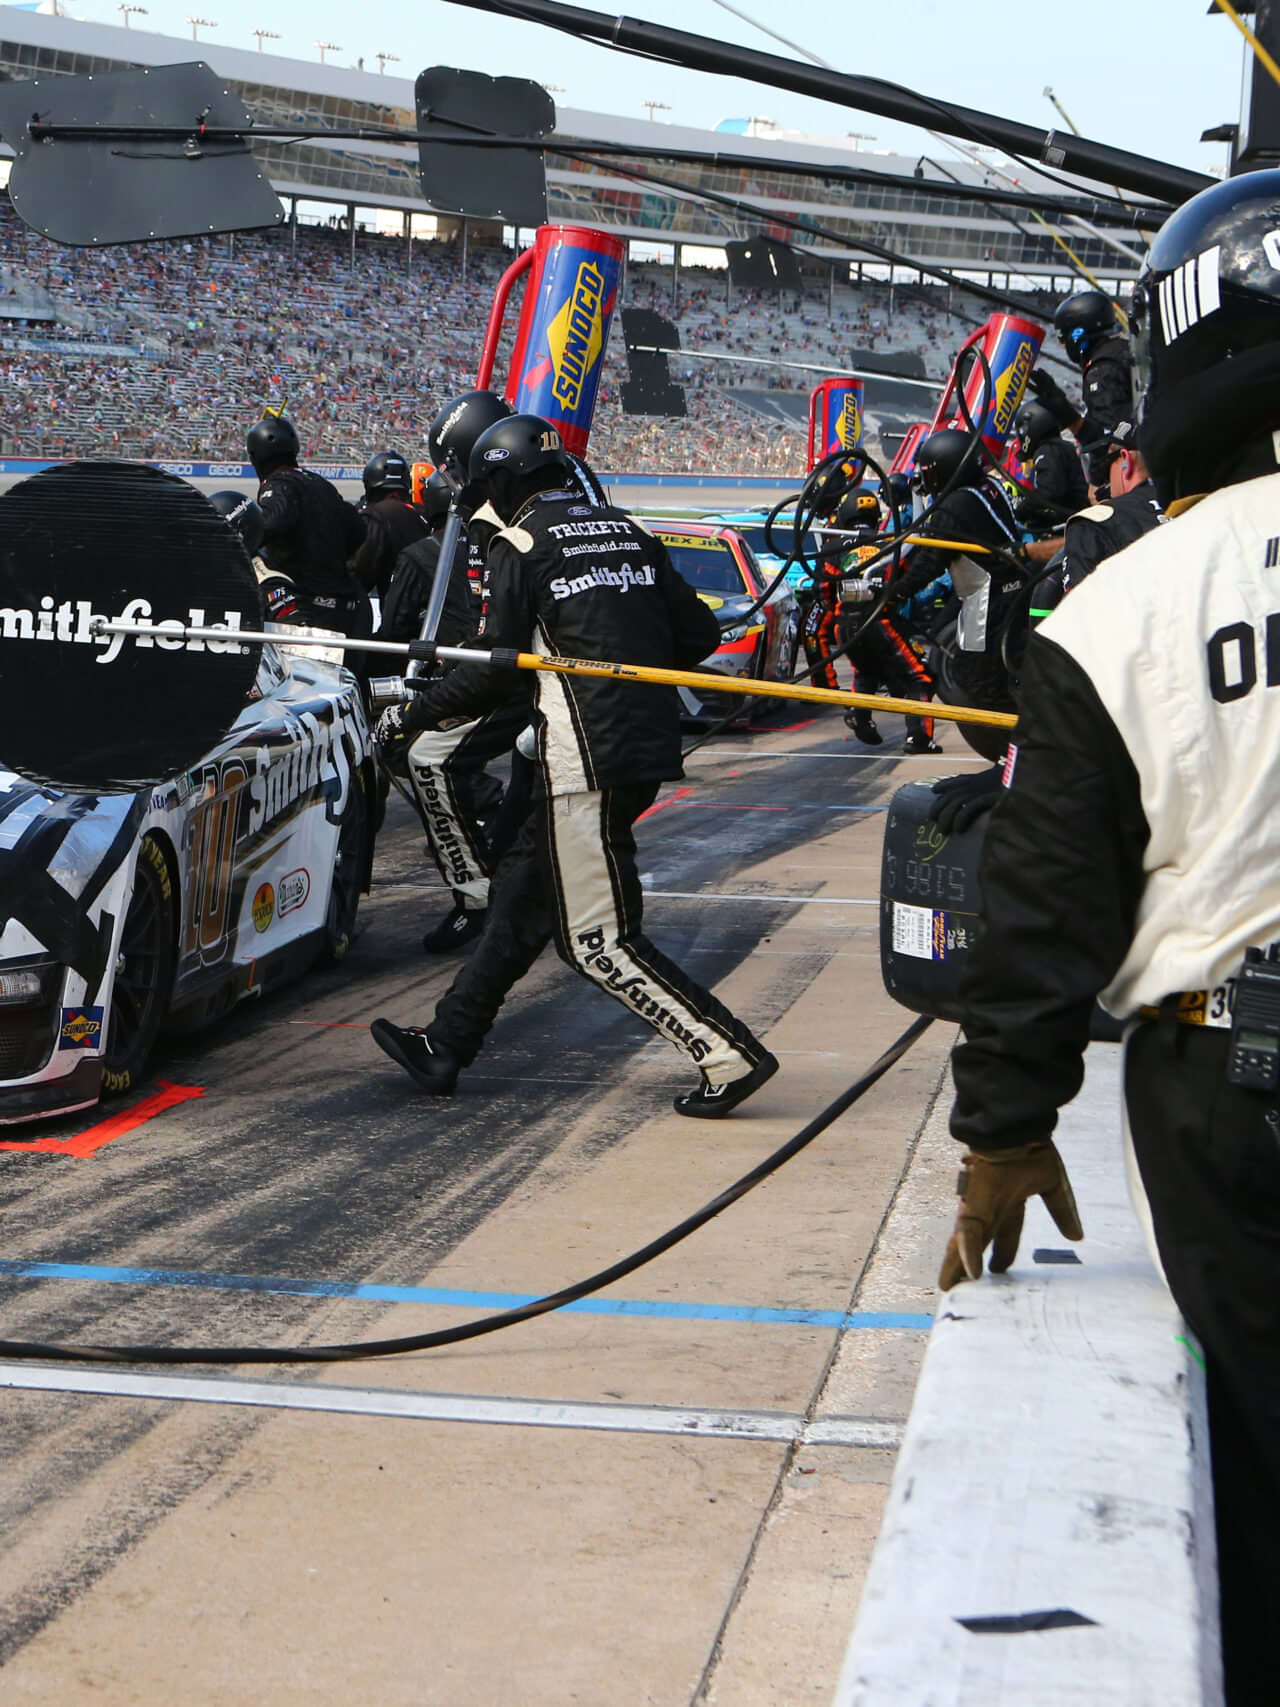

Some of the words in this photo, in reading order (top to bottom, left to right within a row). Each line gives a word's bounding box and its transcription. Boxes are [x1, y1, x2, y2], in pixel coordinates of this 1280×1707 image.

[555, 268, 603, 408] SUNOCO
[996, 343, 1032, 431] SUNOCO
[540, 431, 560, 451] 10
[844, 393, 857, 451] UNOCO
[208, 464, 243, 476] GEICO
[547, 520, 633, 540] TRICKETT
[562, 540, 642, 557] Smithfield.com
[549, 562, 657, 601] Smithfiel
[414, 764, 474, 885] Smithfield
[578, 924, 713, 1064] Smithfield
[62, 1021, 99, 1036] SUNOCO
